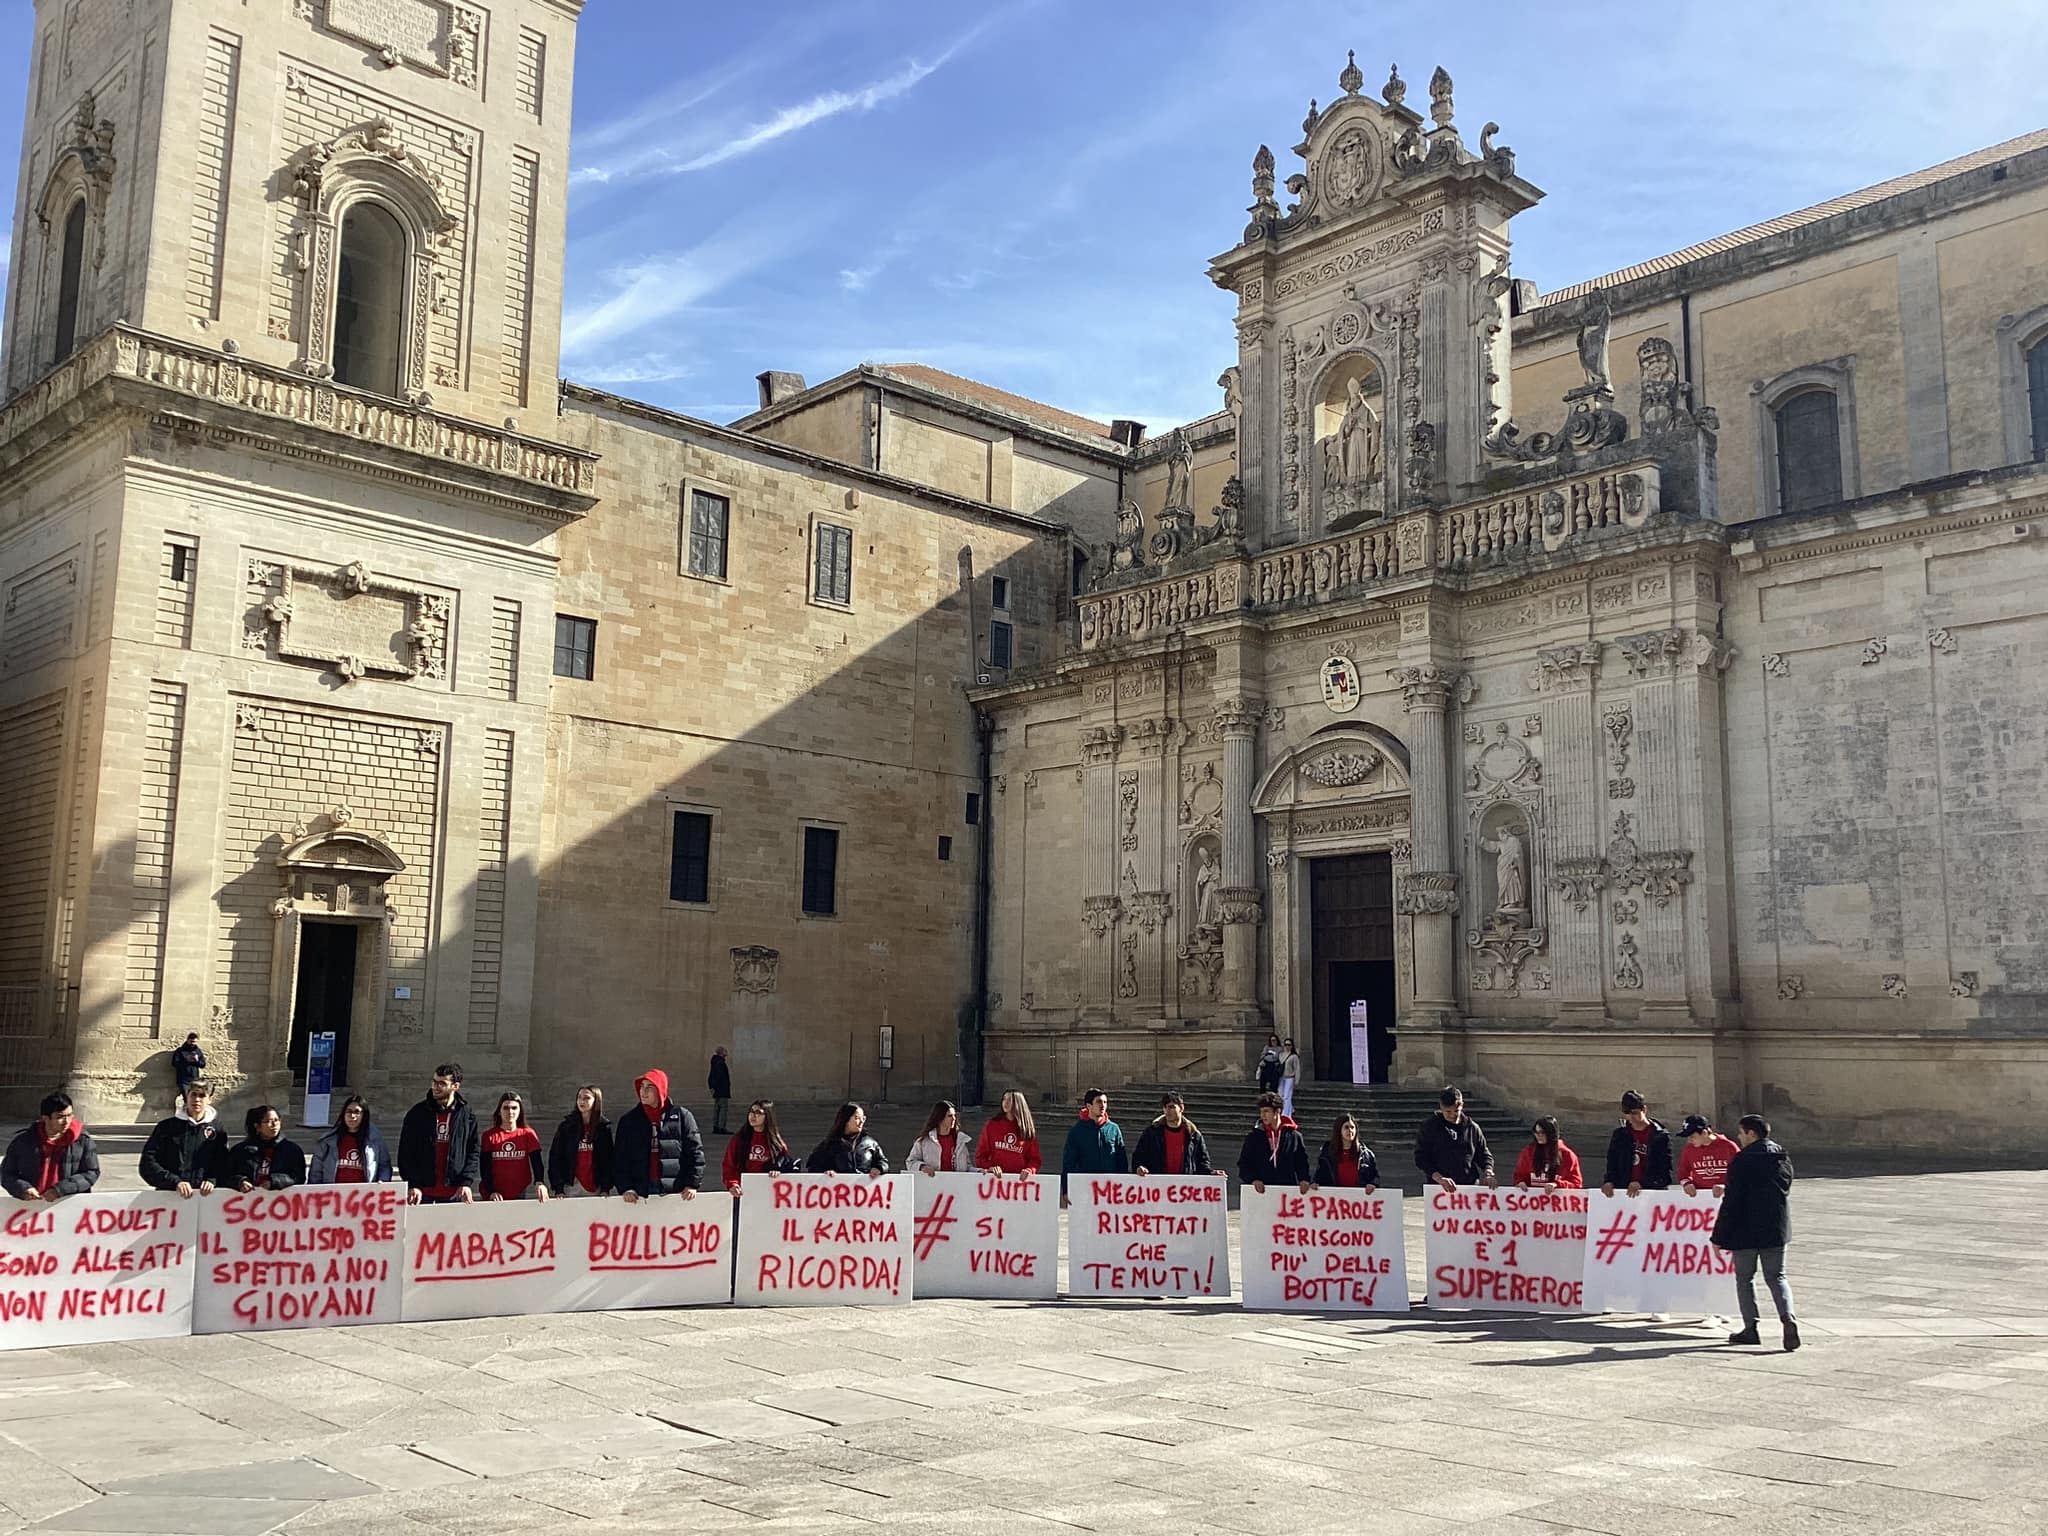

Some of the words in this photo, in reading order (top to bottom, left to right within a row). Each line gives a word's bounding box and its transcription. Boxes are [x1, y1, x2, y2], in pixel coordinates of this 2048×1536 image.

[1693, 1160, 1728, 1168] ANGELES
[772, 1181, 893, 1209] RICORDA!
[978, 1177, 1040, 1202] UNITI
[1092, 1180, 1161, 1205] MEGLIO
[1167, 1184, 1222, 1203] ESSERE
[1433, 1192, 1470, 1212] CHI
[1475, 1193, 1500, 1212] FA
[1277, 1194, 1305, 1218] LE
[1311, 1196, 1384, 1220] PAROLE
[1650, 1204, 1715, 1232] MODE
[5, 1208, 54, 1238] GLI
[75, 1208, 177, 1234] ADULTI
[361, 1219, 396, 1241] RE
[782, 1218, 804, 1242] IL
[813, 1218, 898, 1245] KARMA
[975, 1216, 1004, 1240] SI
[1097, 1213, 1208, 1236] RISPETTATI
[1272, 1223, 1374, 1247] FERISCONO
[1433, 1219, 1458, 1234] UN
[1463, 1218, 1505, 1235] CASO
[1511, 1220, 1528, 1236] DI
[1533, 1220, 1586, 1240] BULLIS
[201, 1231, 228, 1255] IL
[243, 1227, 355, 1255] BULLISMO
[415, 1228, 556, 1271] MABASTA
[588, 1222, 721, 1263] BULLISMO
[1596, 1210, 1638, 1265] #
[72, 1243, 183, 1275] ALLEATI
[970, 1249, 1038, 1277] VINCE
[1126, 1242, 1167, 1263] CHE
[1325, 1253, 1391, 1275] DELLE
[1501, 1239, 1518, 1267] 1
[213, 1261, 315, 1286] SPETTA
[323, 1258, 340, 1284] A
[346, 1257, 388, 1284] NOI
[758, 1254, 902, 1296] RICORDA!
[1083, 1256, 1214, 1294] TEMUTI!
[1284, 1277, 1378, 1306] BOTTE!
[1435, 1265, 1583, 1307] SUPEREROE
[0, 1290, 47, 1322] NON
[58, 1287, 166, 1322] NEMICI
[233, 1286, 376, 1325] GIOVANI
